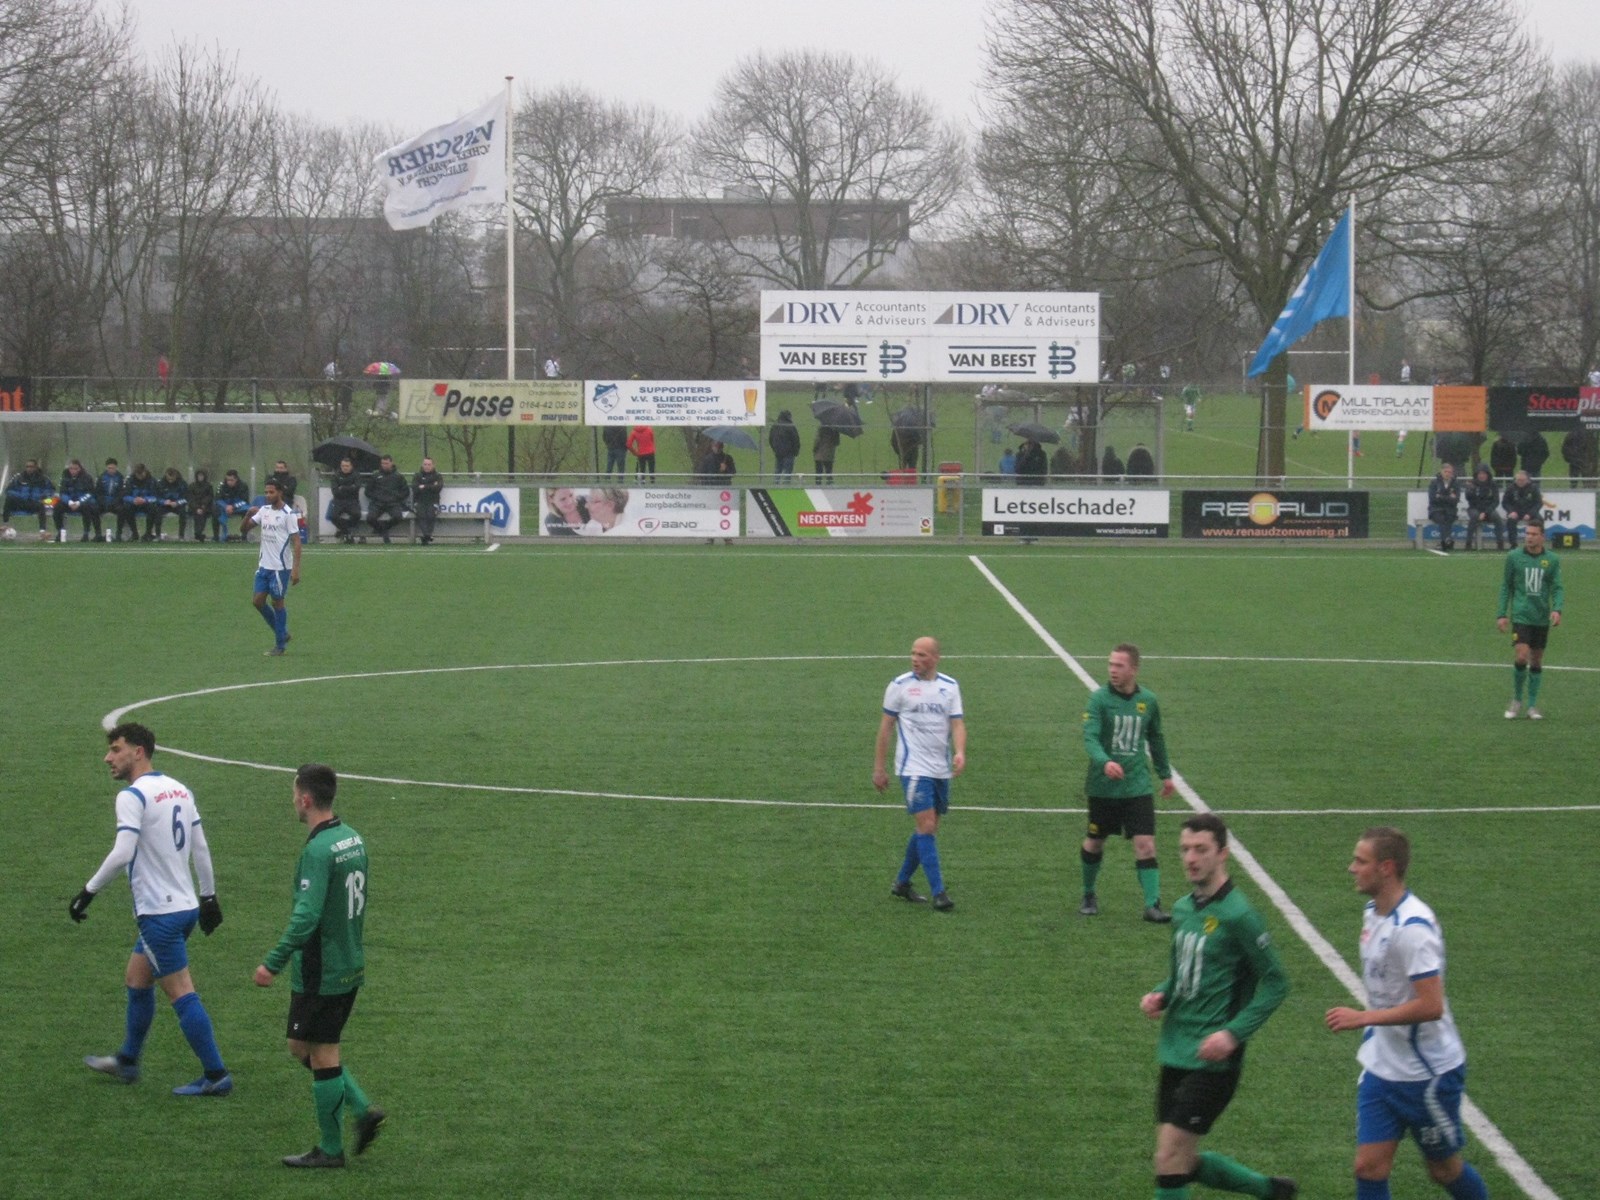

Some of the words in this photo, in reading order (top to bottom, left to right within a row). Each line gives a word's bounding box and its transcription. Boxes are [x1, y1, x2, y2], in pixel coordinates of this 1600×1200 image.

[855, 301, 927, 312] Accountants
[1024, 302, 1096, 313] Accountants
[787, 302, 850, 324] DRV
[956, 303, 1019, 325] DRV
[855, 315, 863, 325] &
[867, 315, 927, 326] Adviseurs
[1024, 316, 1032, 327] &
[1036, 316, 1096, 327] Adviseurs
[780, 352, 815, 365] VAN
[822, 352, 867, 366] BEEST
[949, 353, 984, 367] VAN
[991, 354, 1036, 367] BEEST
[639, 386, 712, 394] SUPPORTERS
[443, 389, 514, 417] Passe
[1341, 397, 1430, 407] MULTIPLAAT
[644, 492, 692, 500] Doordachte
[994, 496, 1136, 516] Letselschade?
[799, 514, 864, 525] NEDERVEEN
[1202, 526, 1349, 538] www.renaudzonwering.nl
[172, 804, 186, 851] 6
[345, 870, 365, 920] 18
